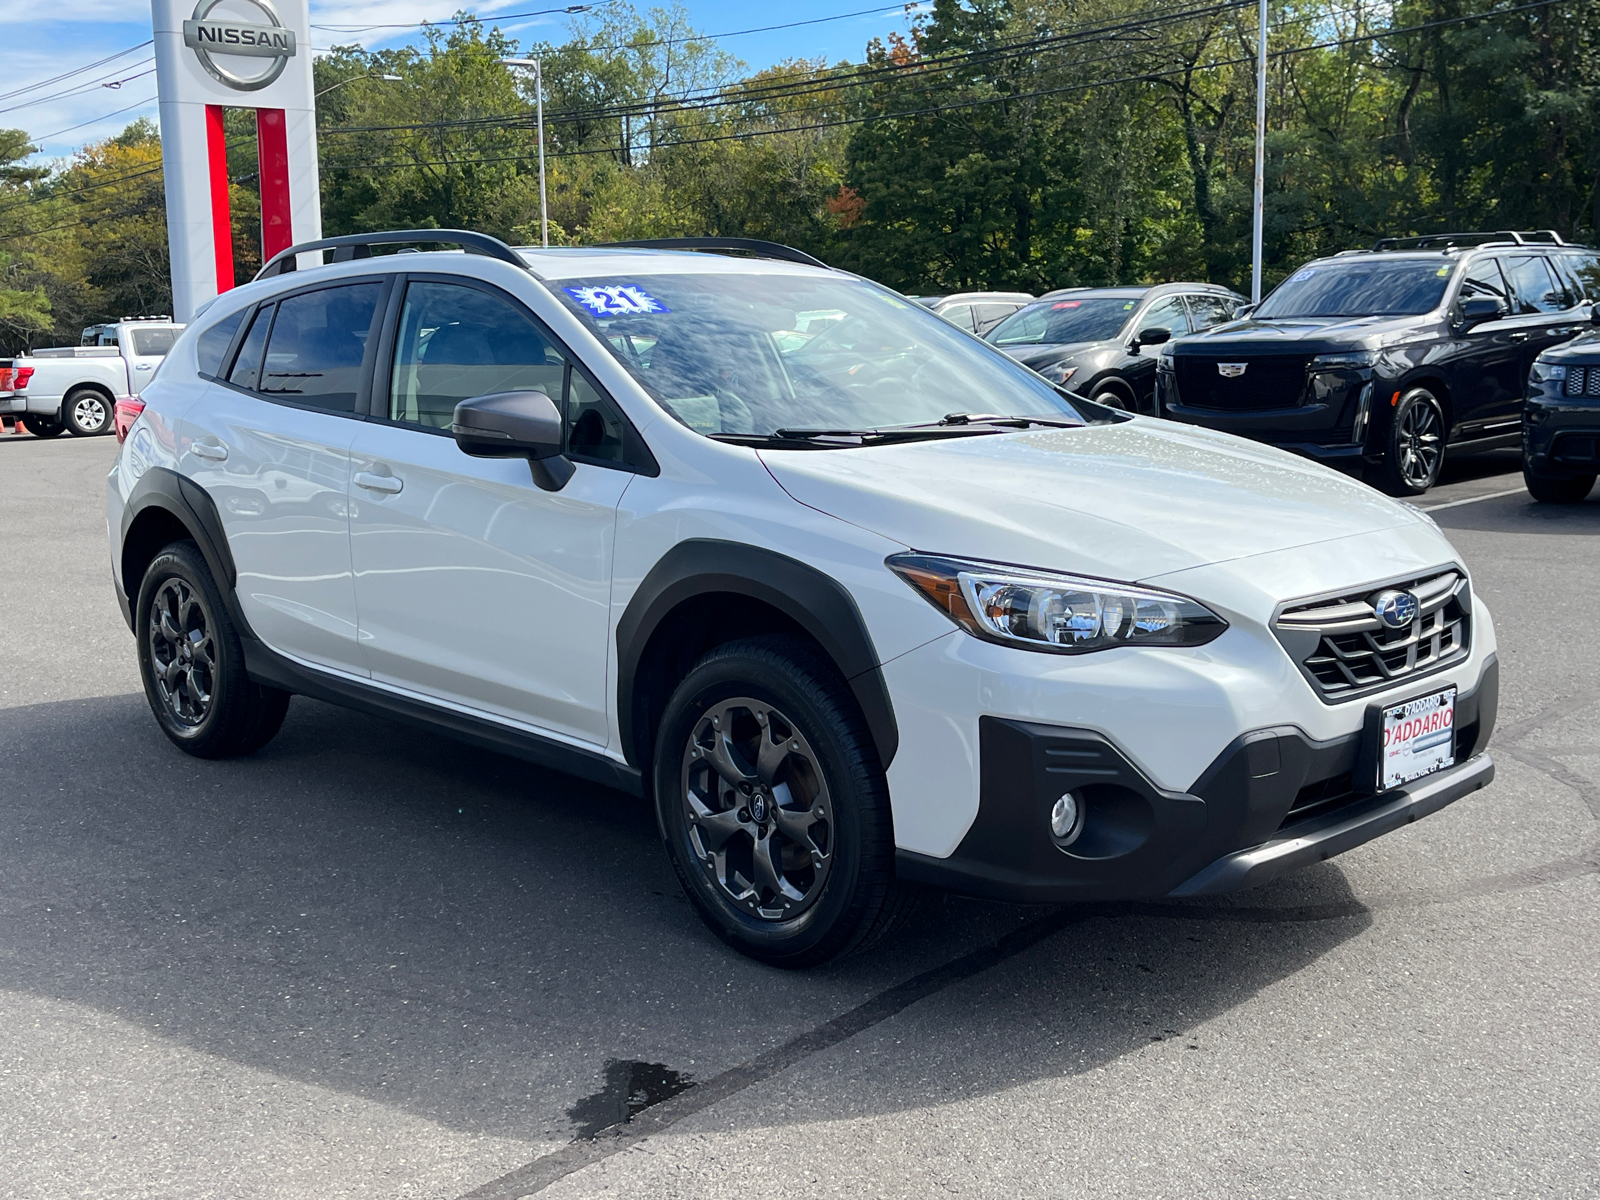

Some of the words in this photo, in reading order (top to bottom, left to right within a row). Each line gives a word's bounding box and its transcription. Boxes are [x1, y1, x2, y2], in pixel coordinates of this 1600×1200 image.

[197, 26, 288, 50] NISSAN
[593, 290, 640, 309] 21
[1405, 695, 1441, 716] D'ADDARIO
[1384, 708, 1453, 747] D'ADDARIO
